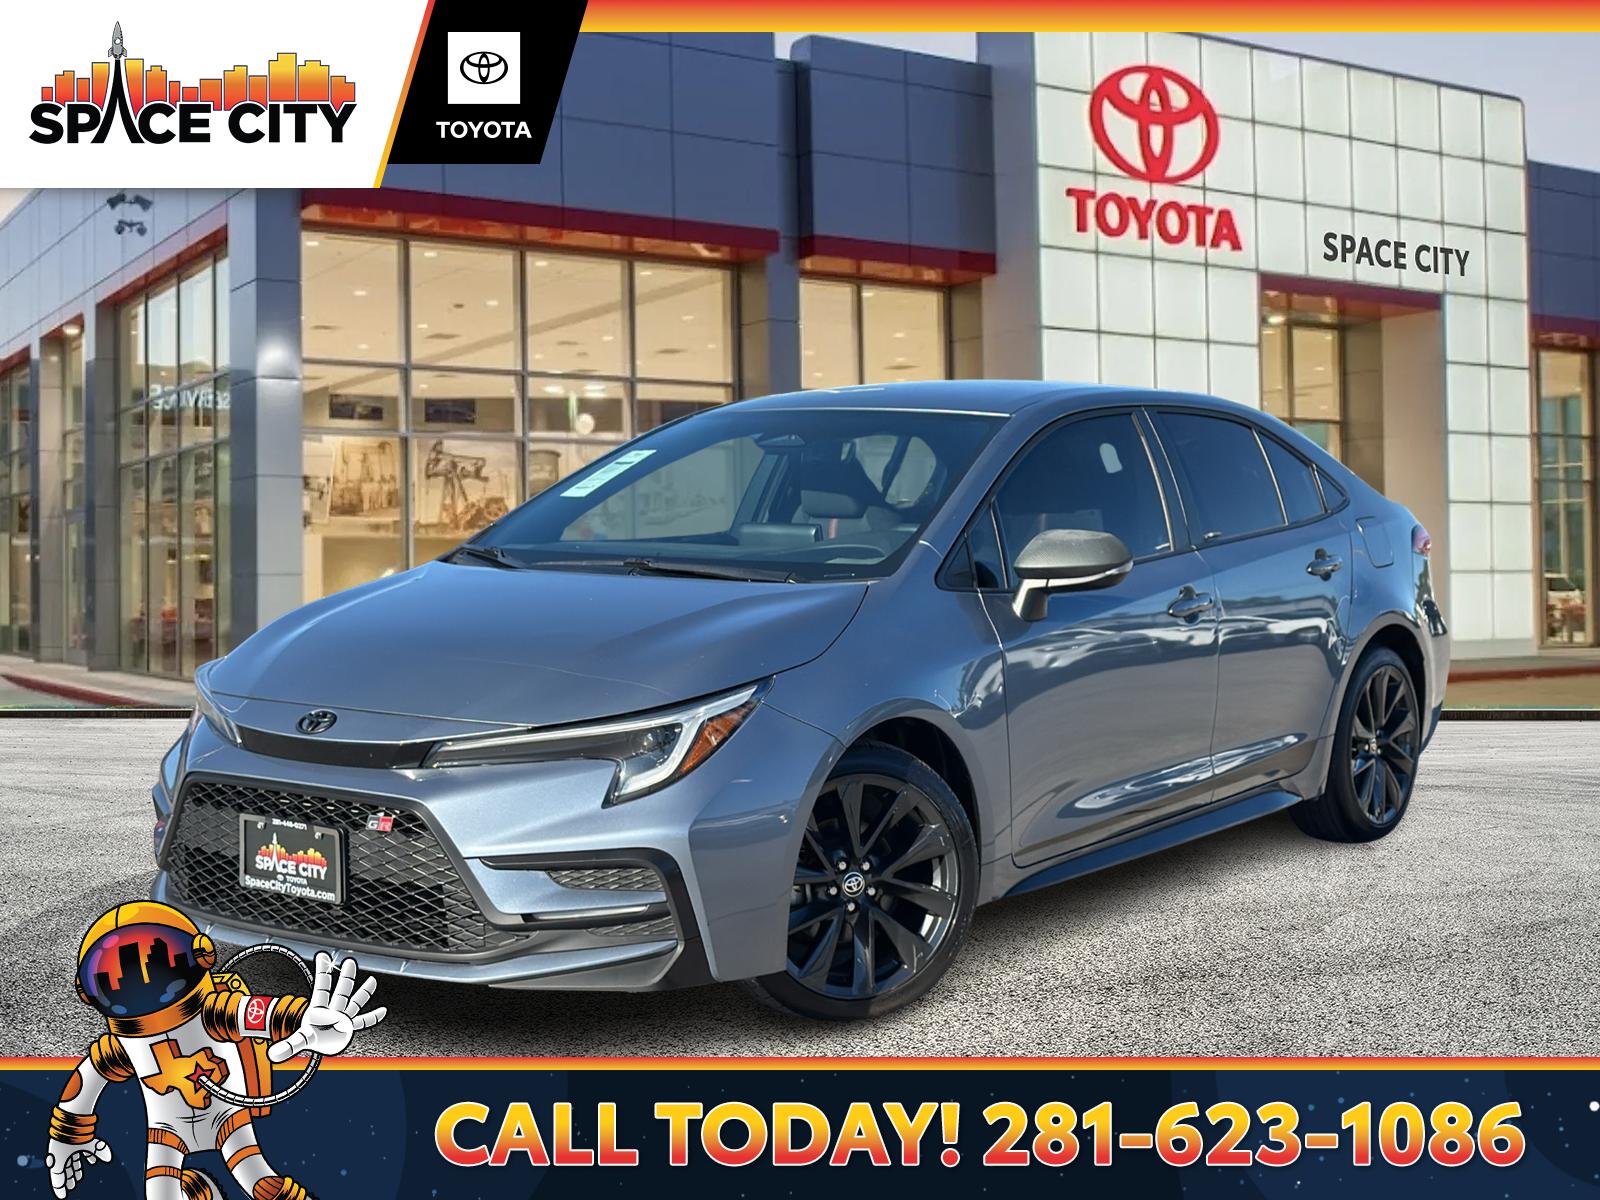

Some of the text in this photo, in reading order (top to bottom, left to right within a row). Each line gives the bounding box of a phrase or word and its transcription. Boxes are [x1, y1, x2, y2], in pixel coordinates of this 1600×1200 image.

[1066, 187, 1243, 251] TOYOTA
[1323, 231, 1470, 276] SPACE CITY
[368, 819, 392, 832] GR
[255, 853, 328, 880] SPACE CITY
[245, 875, 336, 901] SpaceCityToyota.com
[286, 875, 308, 885] TOYOTA
